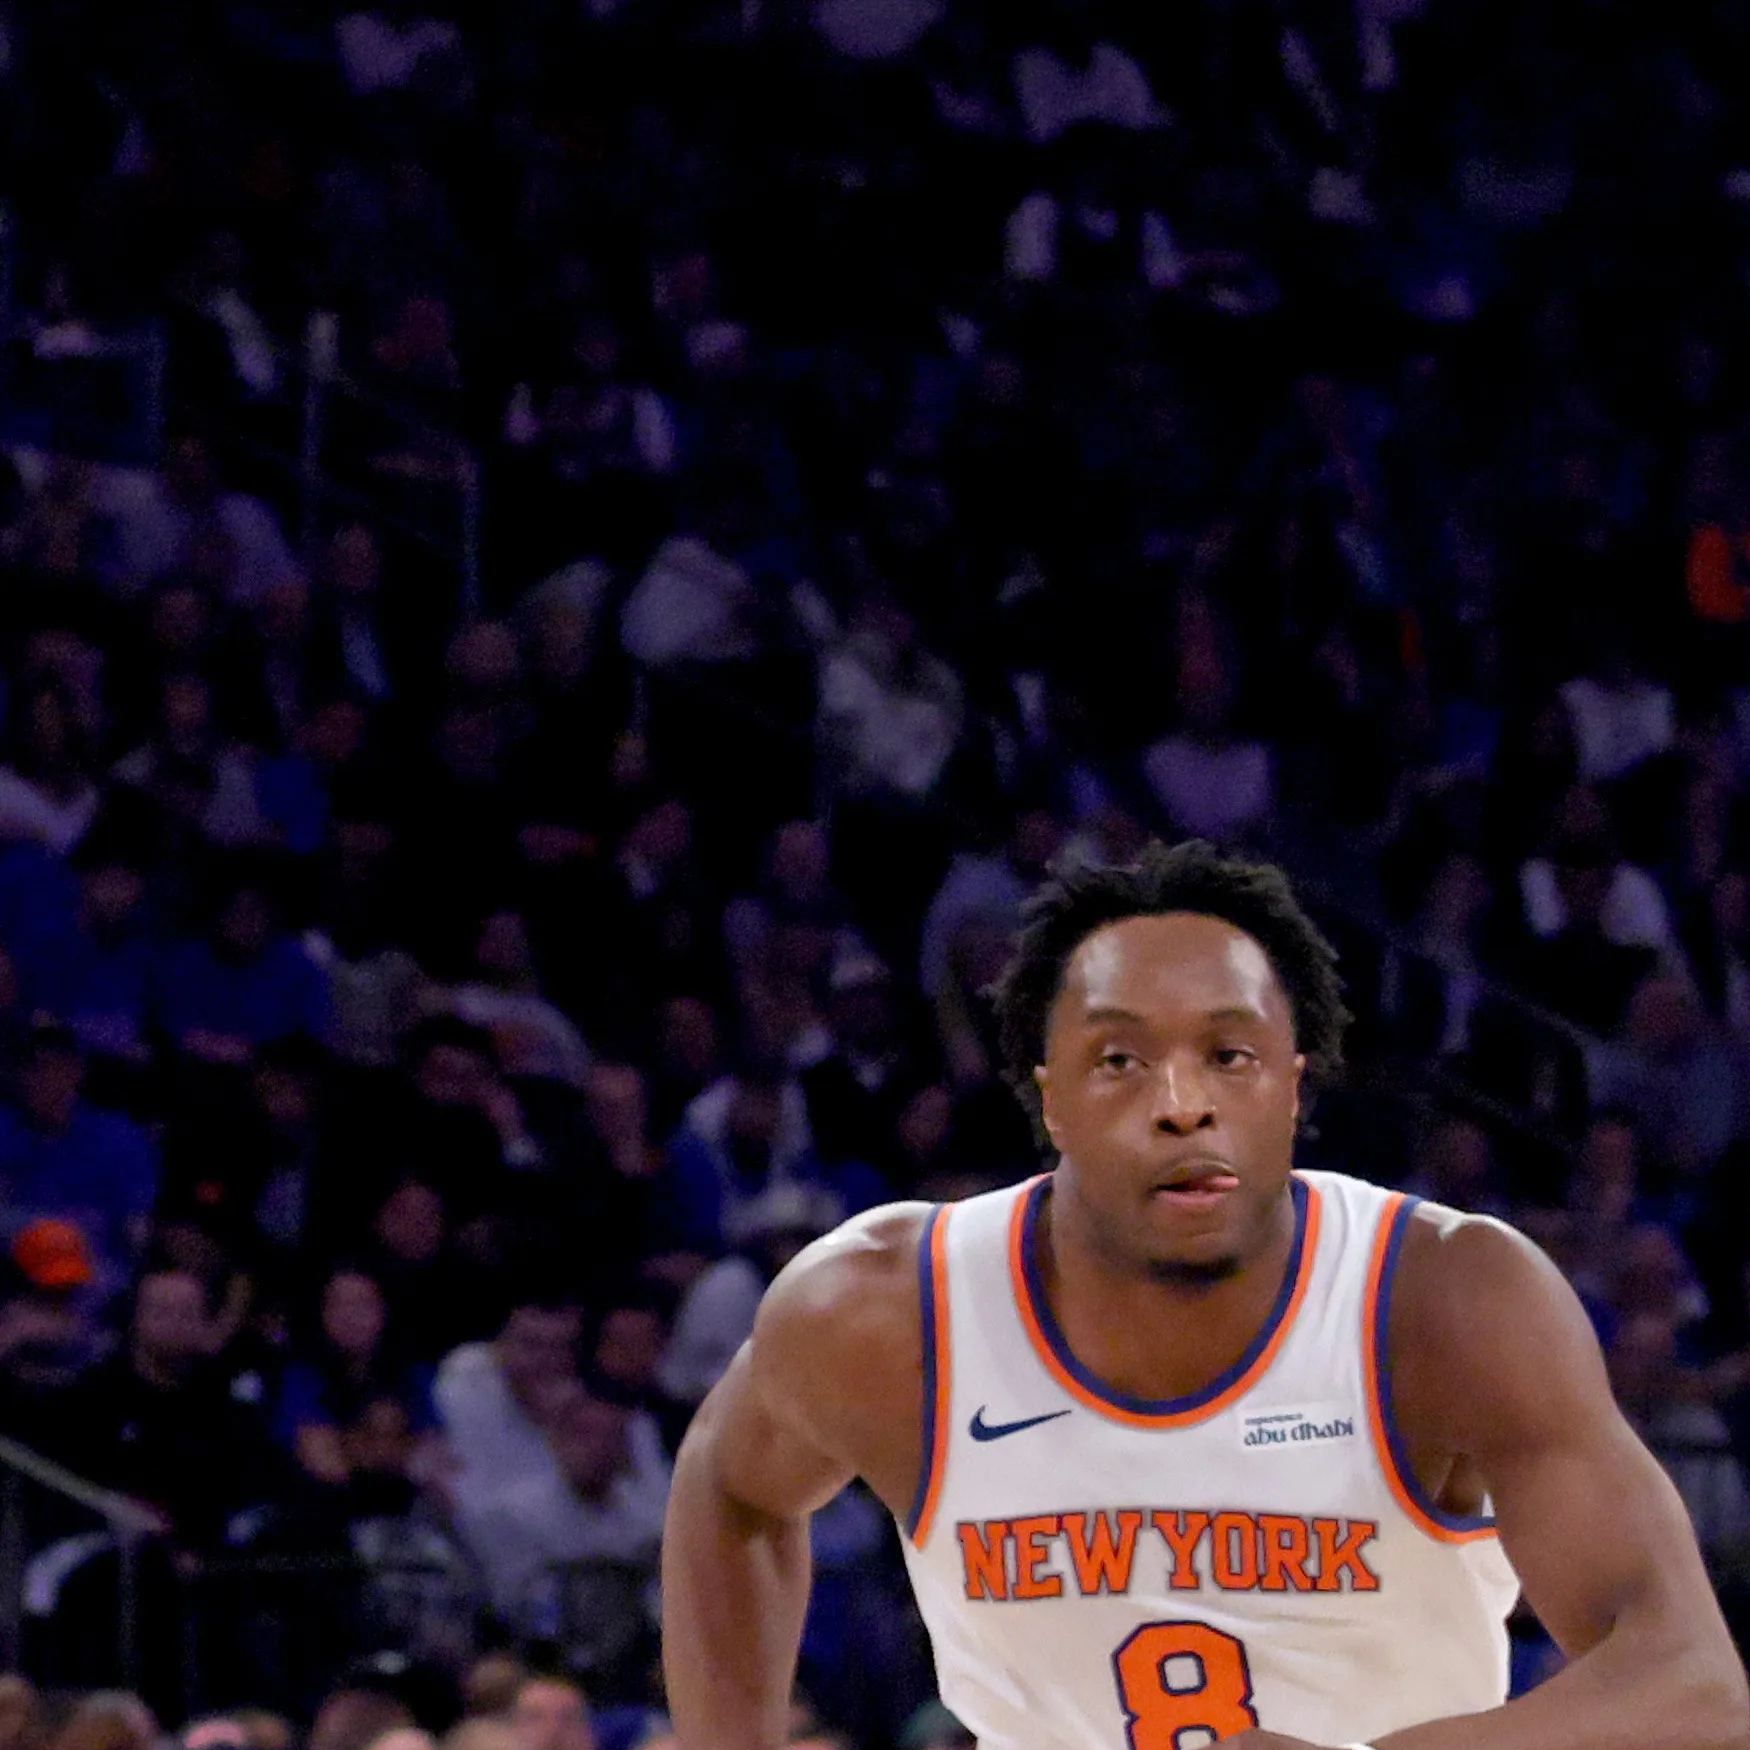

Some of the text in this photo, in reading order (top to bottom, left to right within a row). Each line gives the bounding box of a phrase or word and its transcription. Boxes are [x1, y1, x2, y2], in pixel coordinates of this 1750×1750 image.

[1244, 1427, 1287, 1446] abu
[1291, 1416, 1354, 1440] dhabi
[957, 1510, 1382, 1600] NEW YORK
